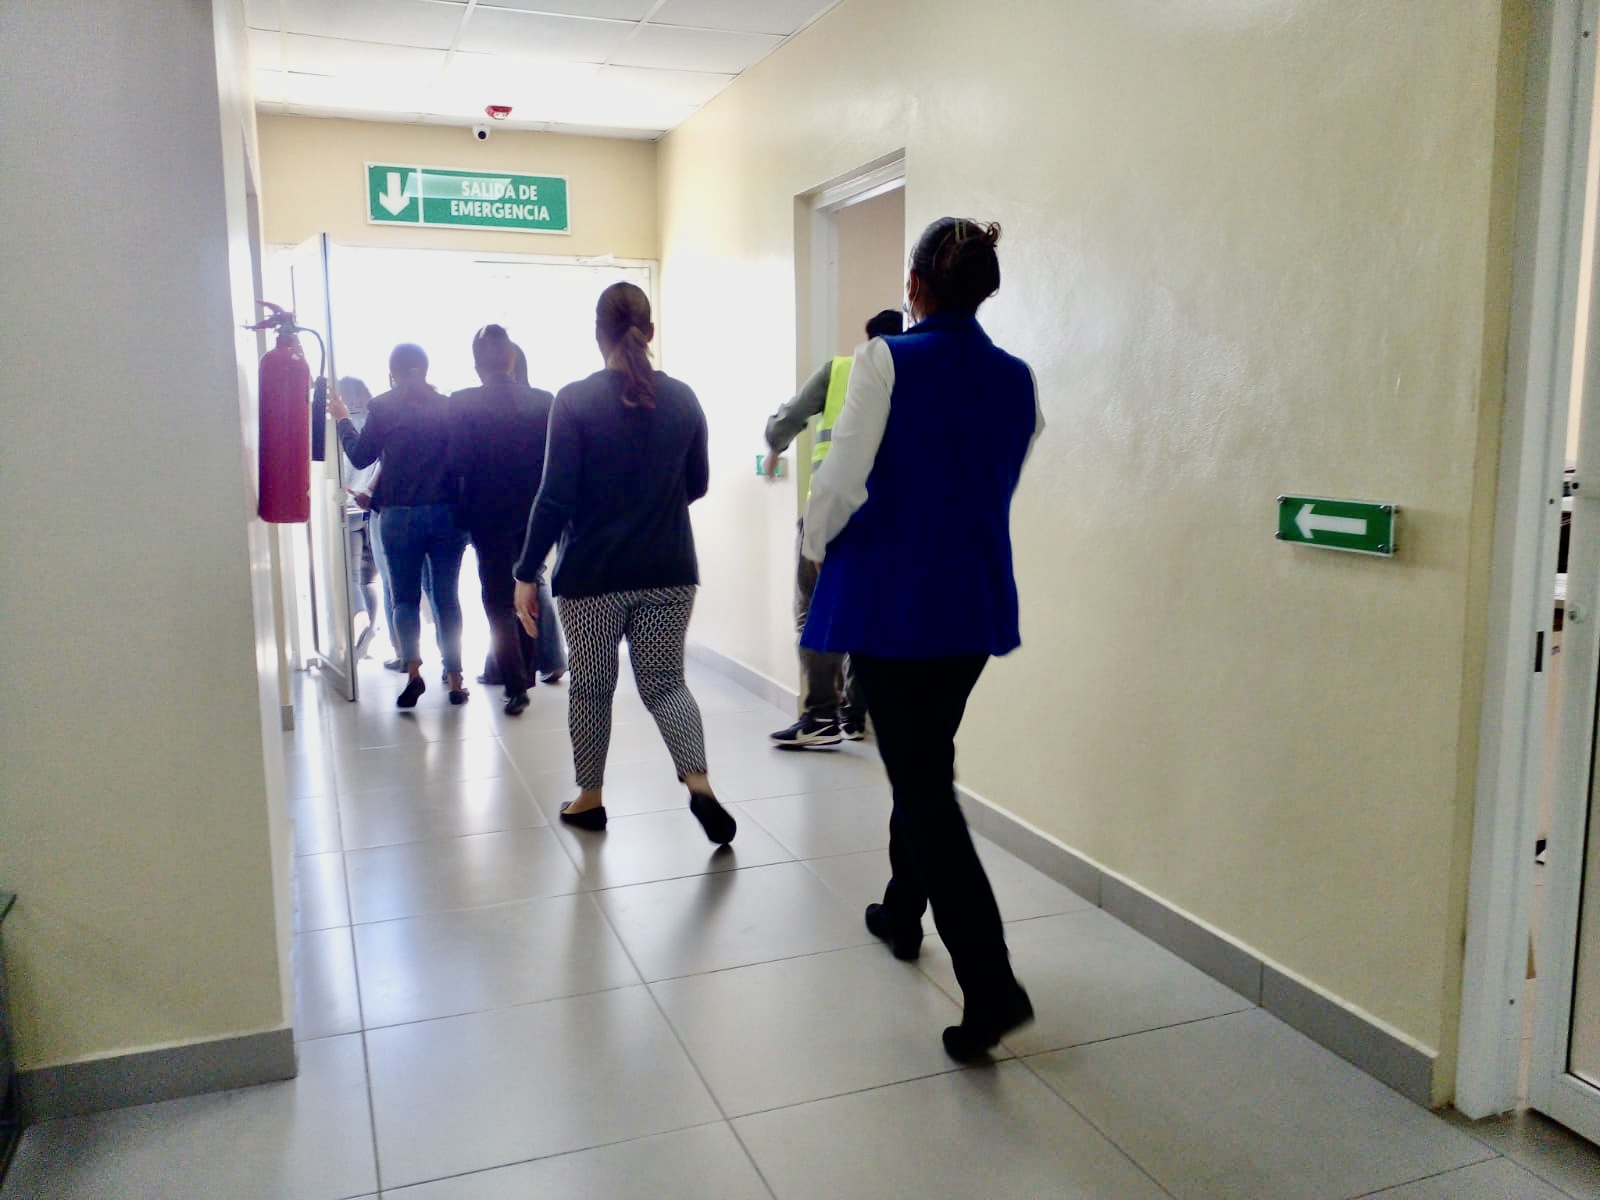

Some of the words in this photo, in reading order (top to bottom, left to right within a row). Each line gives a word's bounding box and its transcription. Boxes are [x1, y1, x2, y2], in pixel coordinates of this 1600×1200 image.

[461, 180, 516, 199] SALIDA
[519, 184, 538, 201] DE
[450, 201, 550, 221] EMERGENCIA
